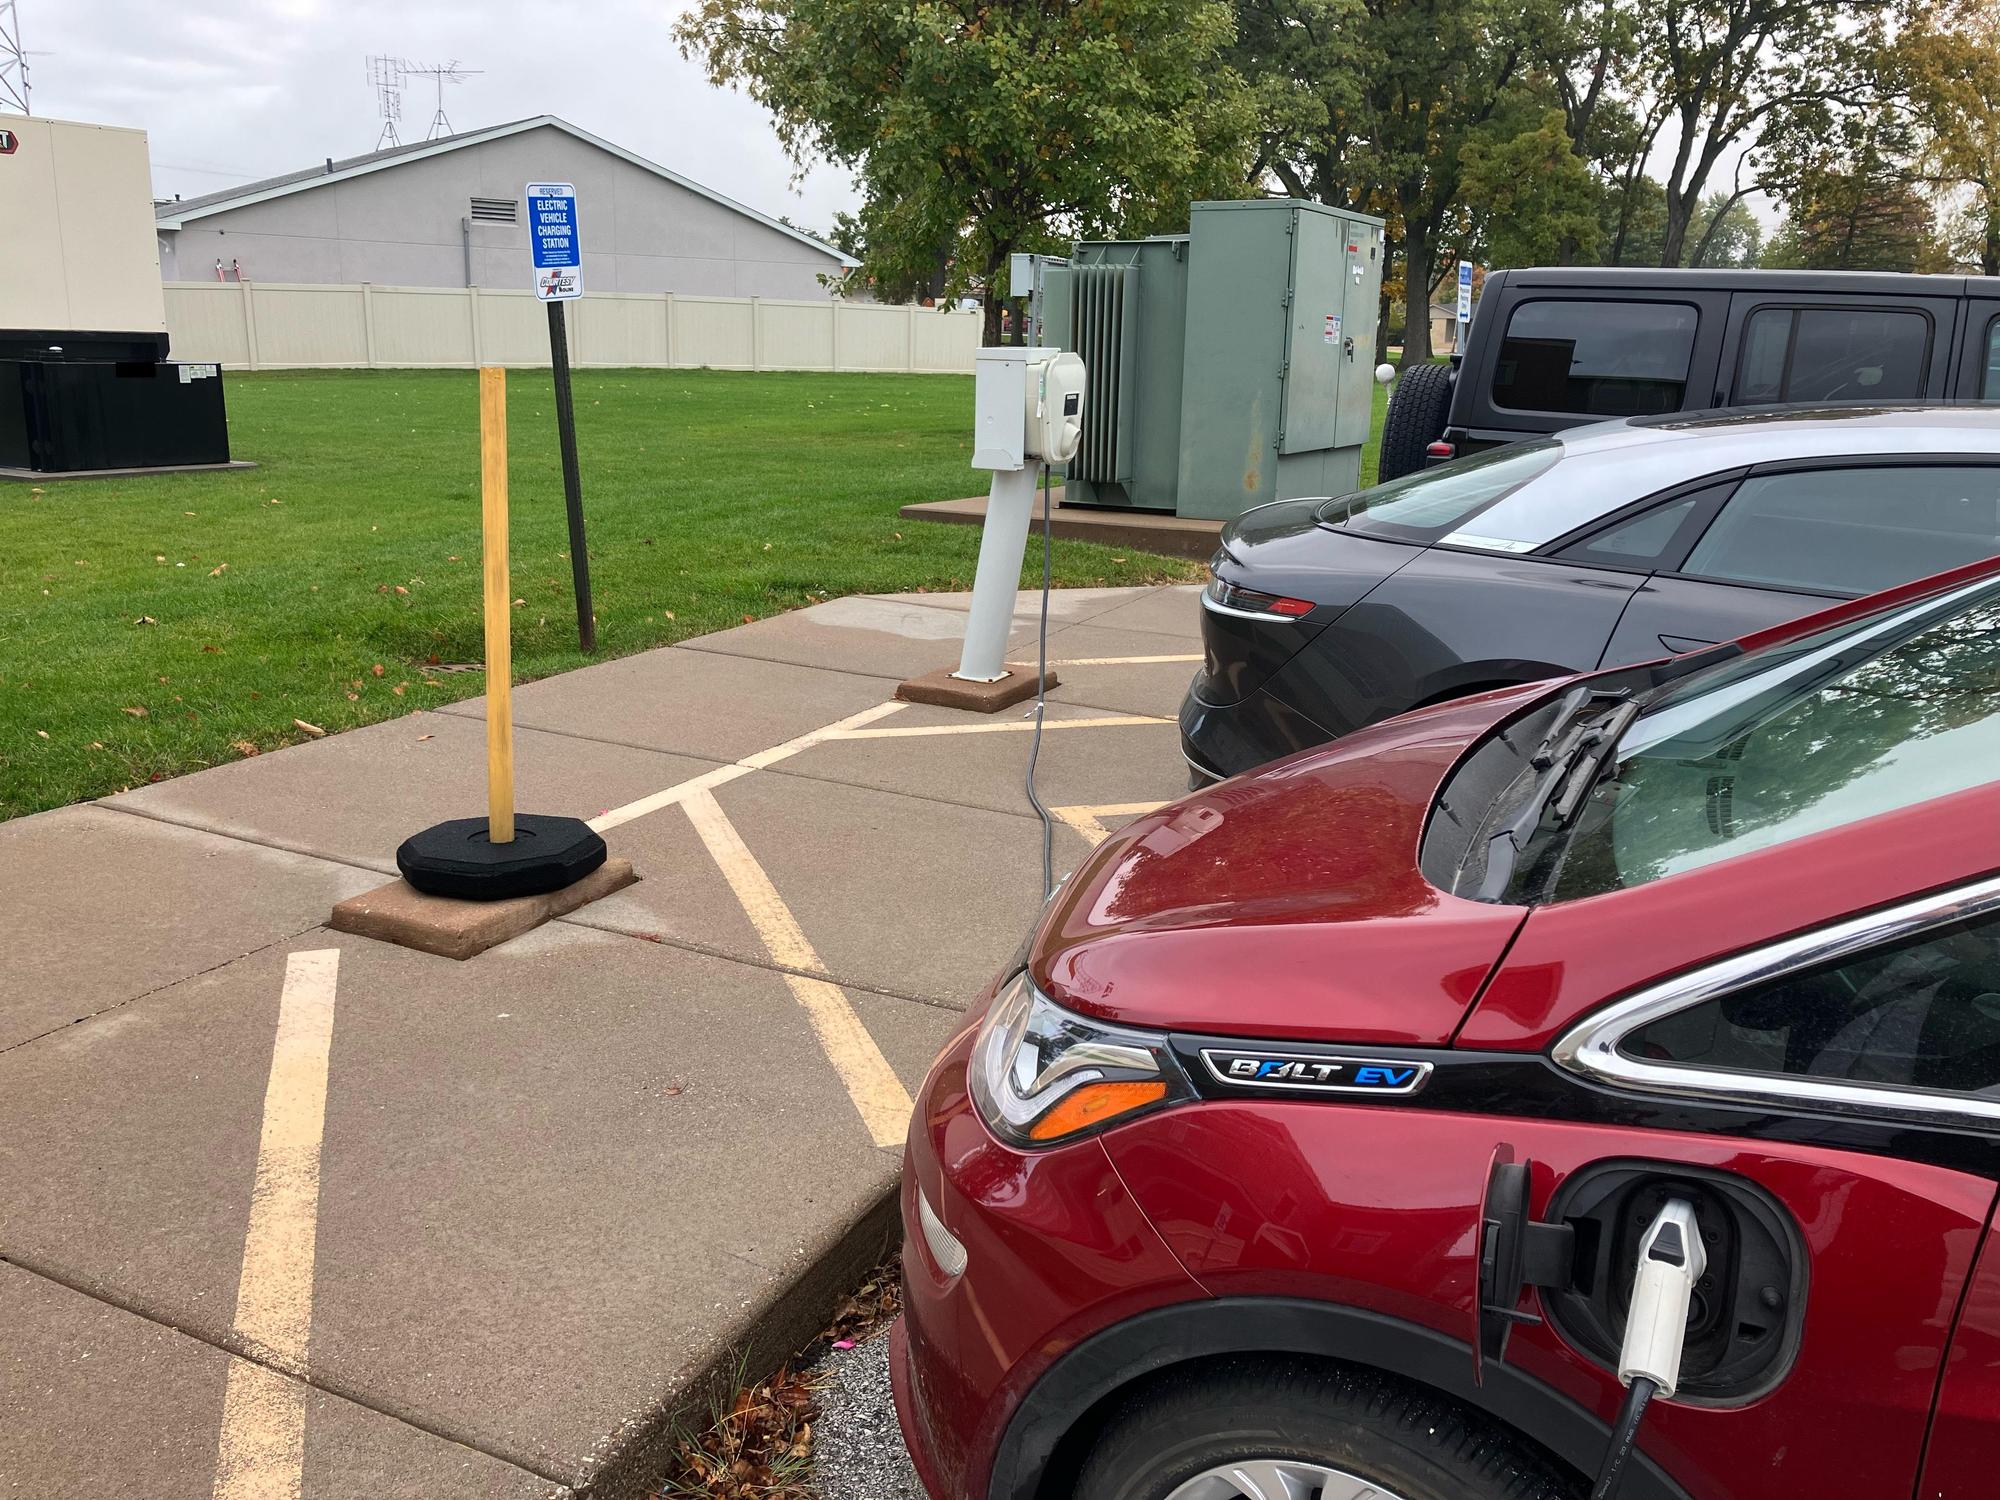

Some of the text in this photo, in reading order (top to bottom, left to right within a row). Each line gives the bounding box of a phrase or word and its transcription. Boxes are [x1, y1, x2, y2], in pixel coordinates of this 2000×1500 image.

[539, 187, 564, 196] RESERVED
[537, 199, 568, 211] ELECTRIC
[540, 212, 568, 224] VEHICLE
[537, 225, 572, 237] CHARGING
[542, 238, 570, 249] STATION
[540, 276, 577, 288] COURTESY
[1228, 1058, 1415, 1086] BOLT EV
